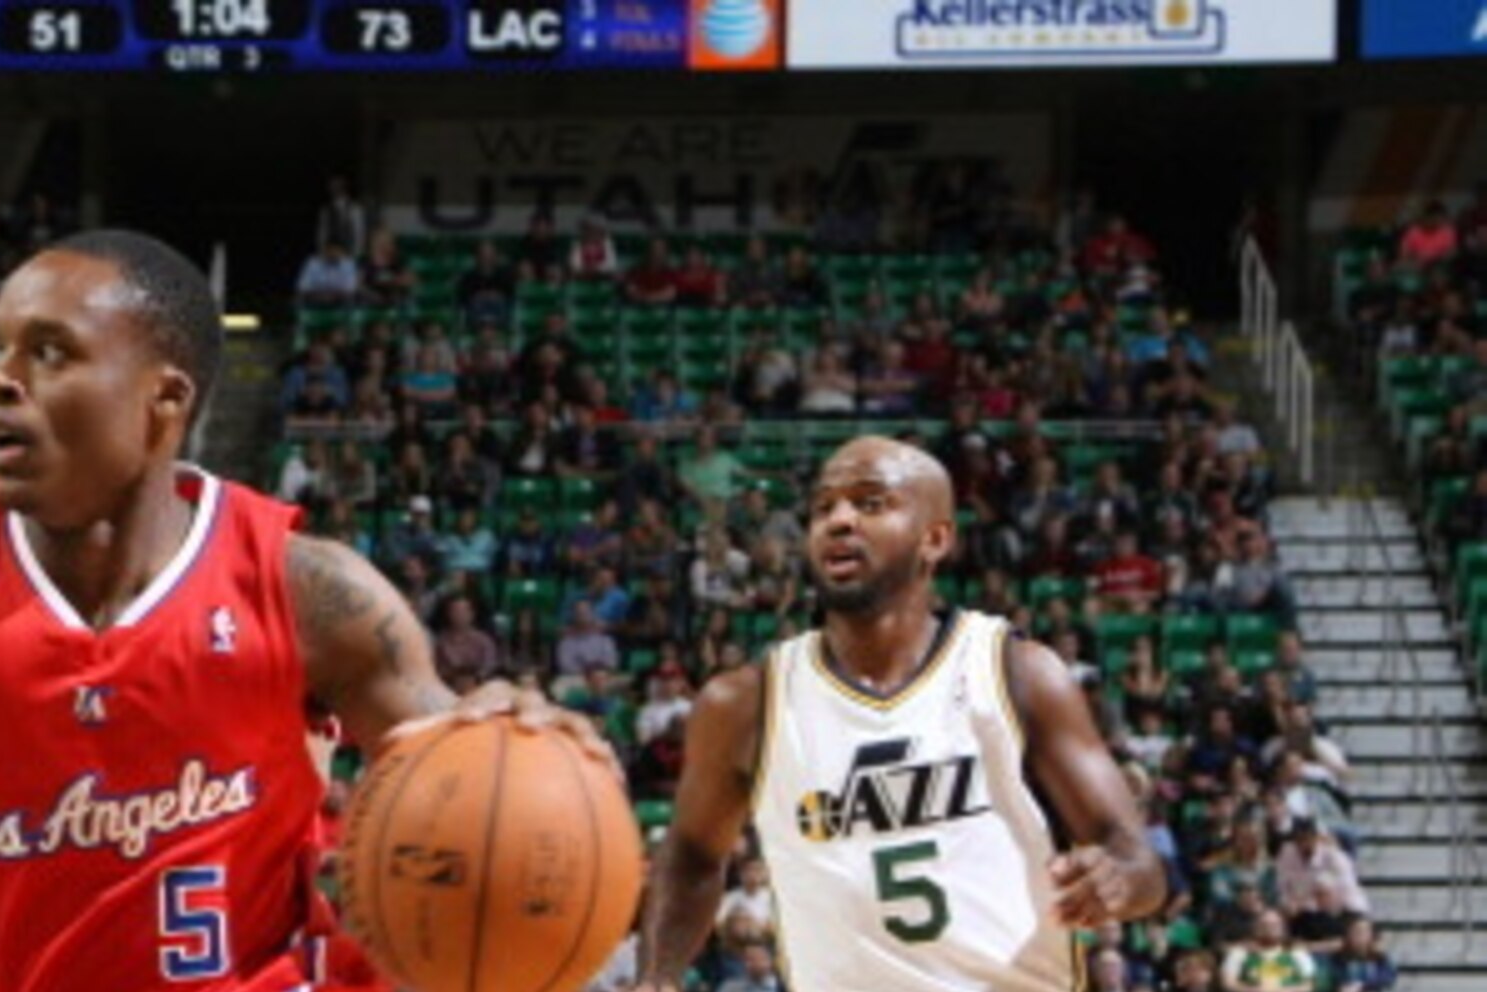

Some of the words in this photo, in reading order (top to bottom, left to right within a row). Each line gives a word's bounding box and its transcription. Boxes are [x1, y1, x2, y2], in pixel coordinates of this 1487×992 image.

[28, 10, 81, 49] 51
[171, 0, 272, 35] 1:04
[357, 9, 411, 48] 73
[468, 10, 561, 48] LAC
[167, 45, 221, 70] QTR
[472, 125, 582, 163] WE
[616, 120, 772, 162] ARE
[420, 173, 758, 231] UTAH
[36, 758, 255, 859] Angeles
[797, 736, 993, 842] JAZZ
[872, 840, 952, 943] 5
[159, 863, 230, 980] 5
